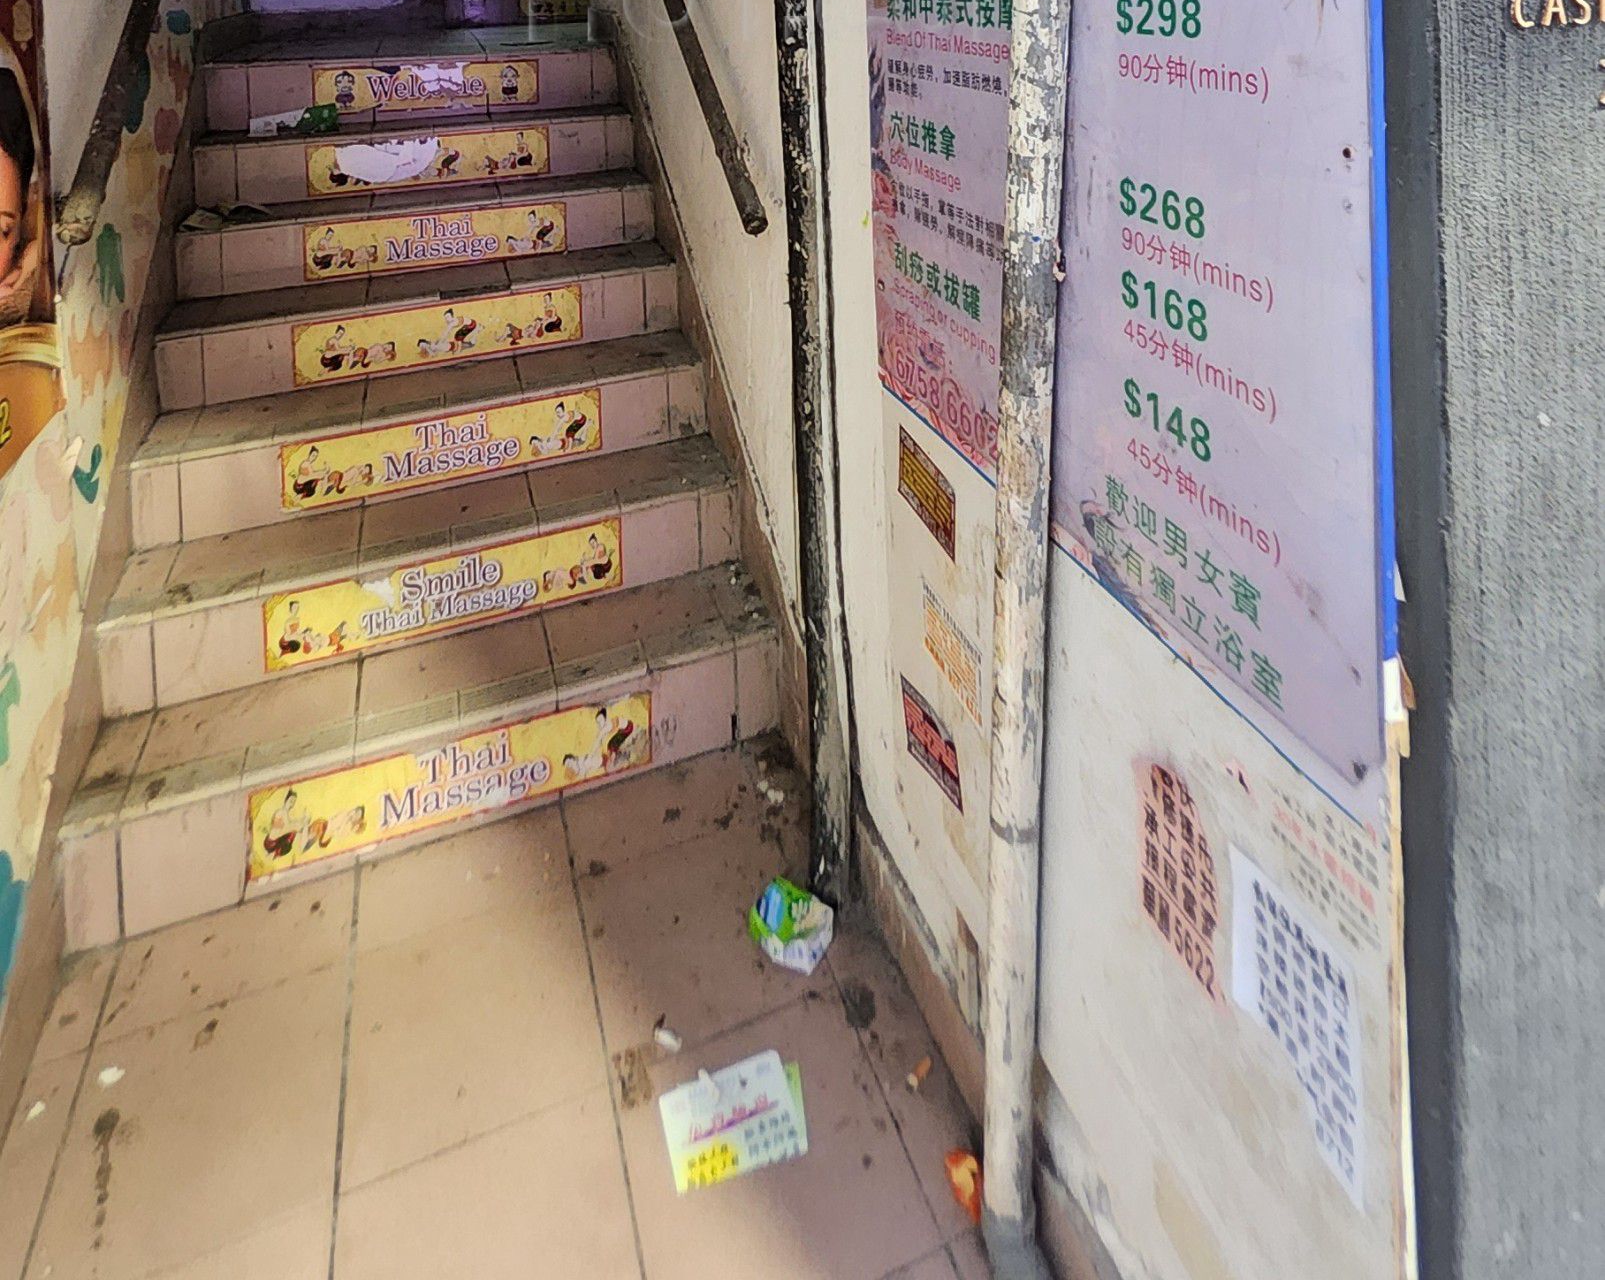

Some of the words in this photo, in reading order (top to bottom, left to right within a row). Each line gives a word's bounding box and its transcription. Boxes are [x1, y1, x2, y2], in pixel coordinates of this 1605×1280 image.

[886, 28, 912, 47] Blend
[914, 31, 926, 48] Of
[928, 32, 952, 53] Thai
[954, 35, 1010, 64] Massage
[1118, 53, 1269, 104] 90分钟(mins)
[890, 111, 957, 161] 穴位推拿
[890, 147, 912, 175] Body
[914, 158, 961, 193] Massage
[413, 214, 473, 240] Thai
[1119, 177, 1206, 238] $268
[386, 236, 499, 262] Massage
[1121, 227, 1275, 312] 90分钟(mins)
[894, 242, 982, 323] 刮痧或拔罐
[1121, 270, 1208, 342] $168
[949, 319, 996, 365] cupping
[1123, 318, 1277, 424] 45分钟(mins)
[415, 413, 488, 453] Thai
[1124, 378, 1212, 463] $148
[382, 438, 520, 483] Massage
[1126, 438, 1282, 568] 45分钟(mins)
[1105, 474, 1262, 631] 歡迎男女賓
[400, 556, 501, 605] Smile
[362, 606, 425, 638] Thai
[429, 579, 538, 622] Massage
[418, 731, 511, 785] Thai
[380, 758, 551, 830] Massage
